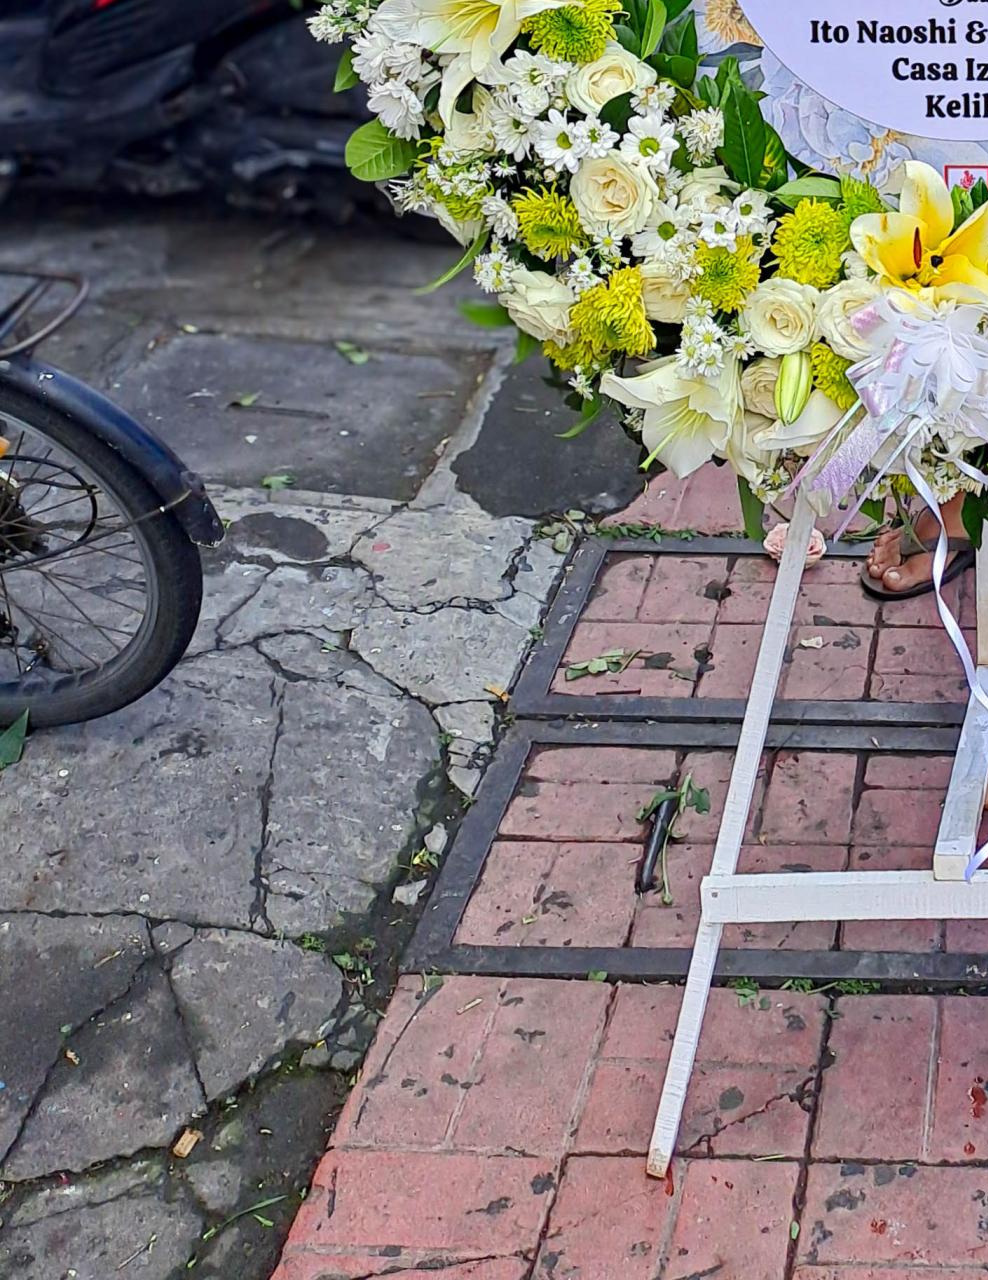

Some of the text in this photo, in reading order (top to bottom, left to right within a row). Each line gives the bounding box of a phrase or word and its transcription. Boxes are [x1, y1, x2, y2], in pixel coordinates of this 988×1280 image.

[809, 20, 850, 45] Ito
[856, 17, 957, 45] Naoshi
[965, 20, 988, 45] &
[891, 57, 959, 82] Casa
